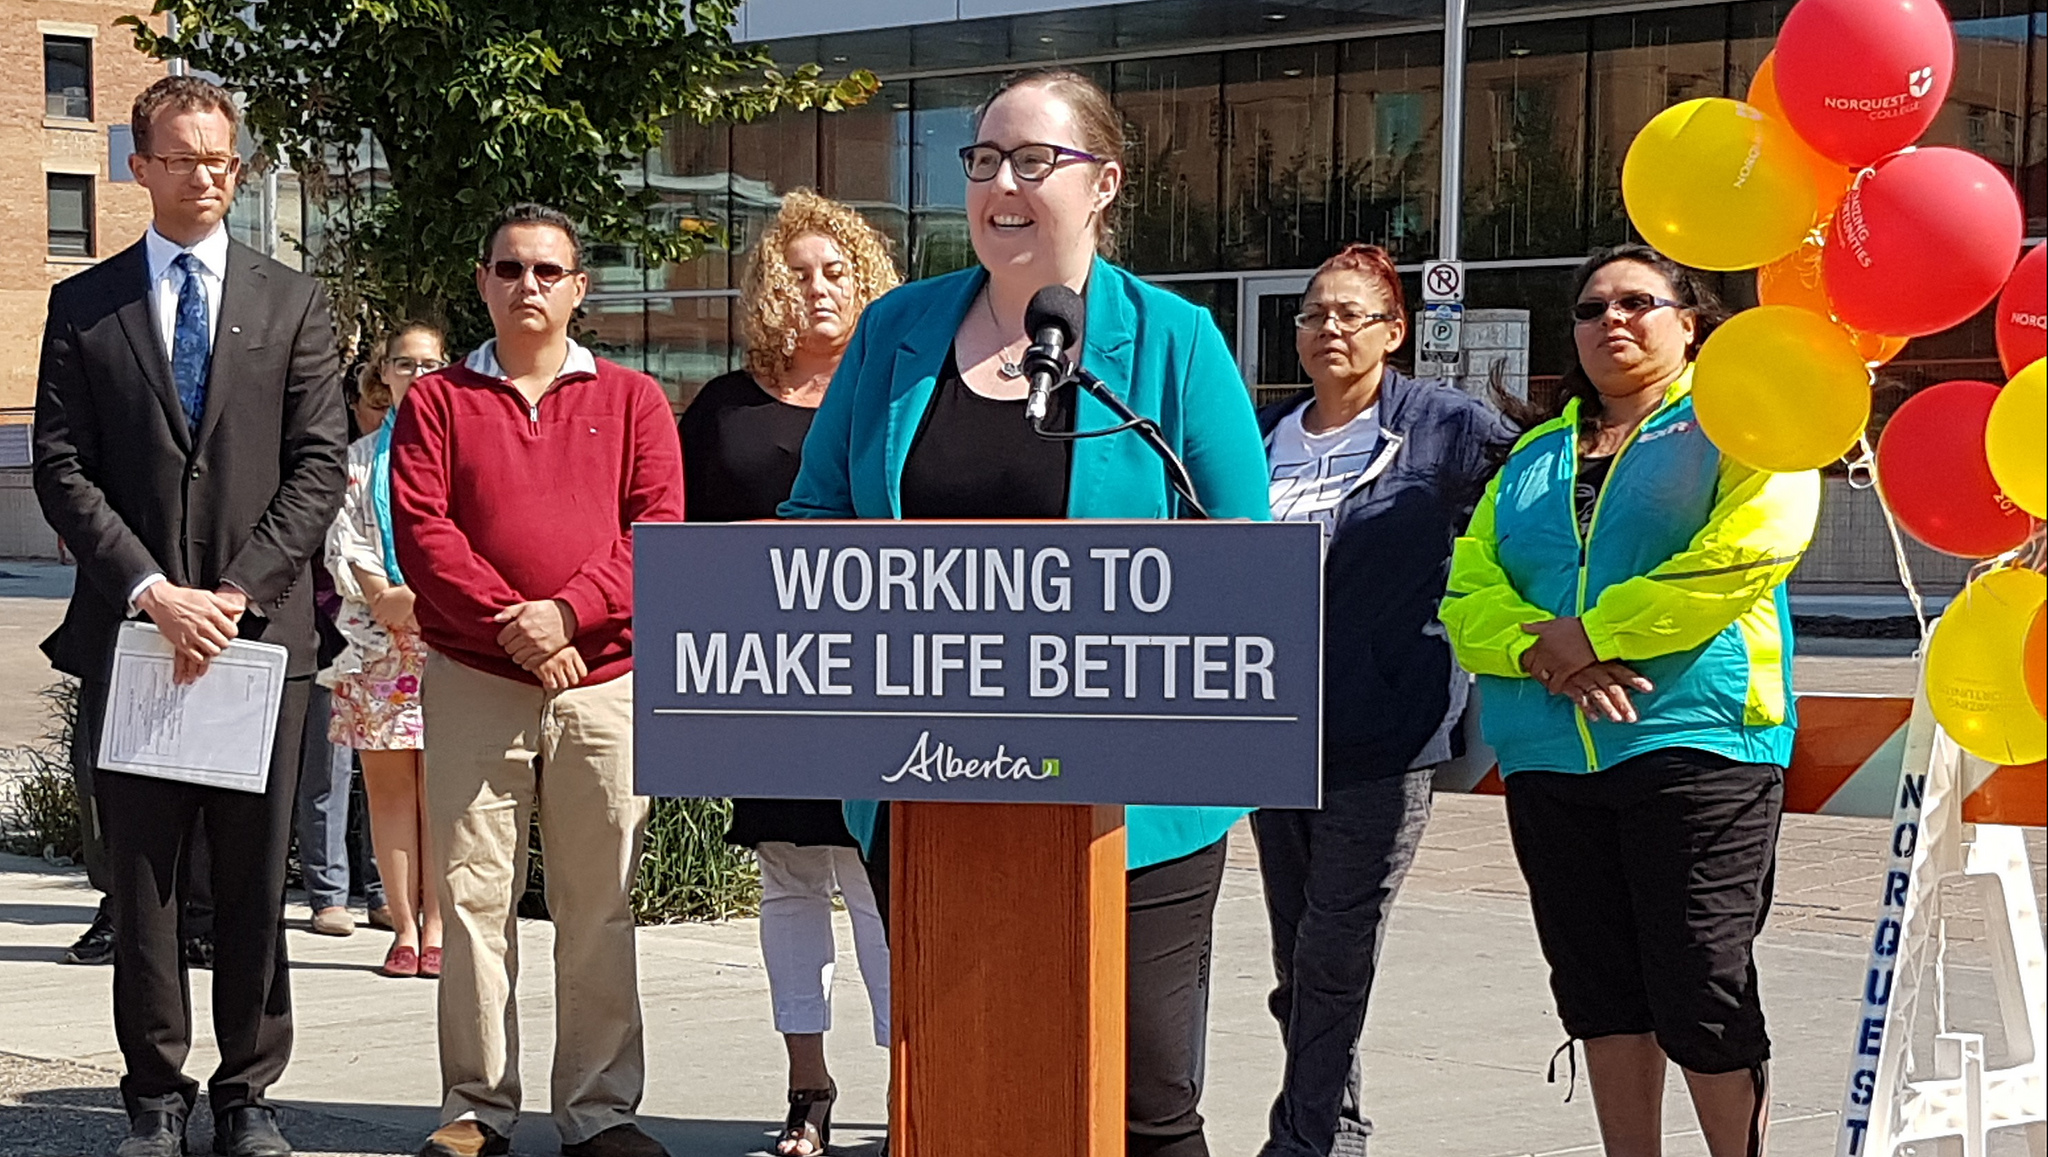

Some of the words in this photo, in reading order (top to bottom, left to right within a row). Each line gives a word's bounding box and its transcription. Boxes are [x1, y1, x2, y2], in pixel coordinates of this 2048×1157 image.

[1824, 93, 1908, 111] NORQUEST
[769, 547, 1071, 612] WORKING
[1090, 547, 1171, 613] TO
[676, 632, 853, 695] MAKE
[876, 633, 1005, 697] LIFE
[1030, 635, 1276, 700] BETTER
[881, 731, 1053, 783] Alberta
[1846, 774, 1925, 1156] NORQUEST
